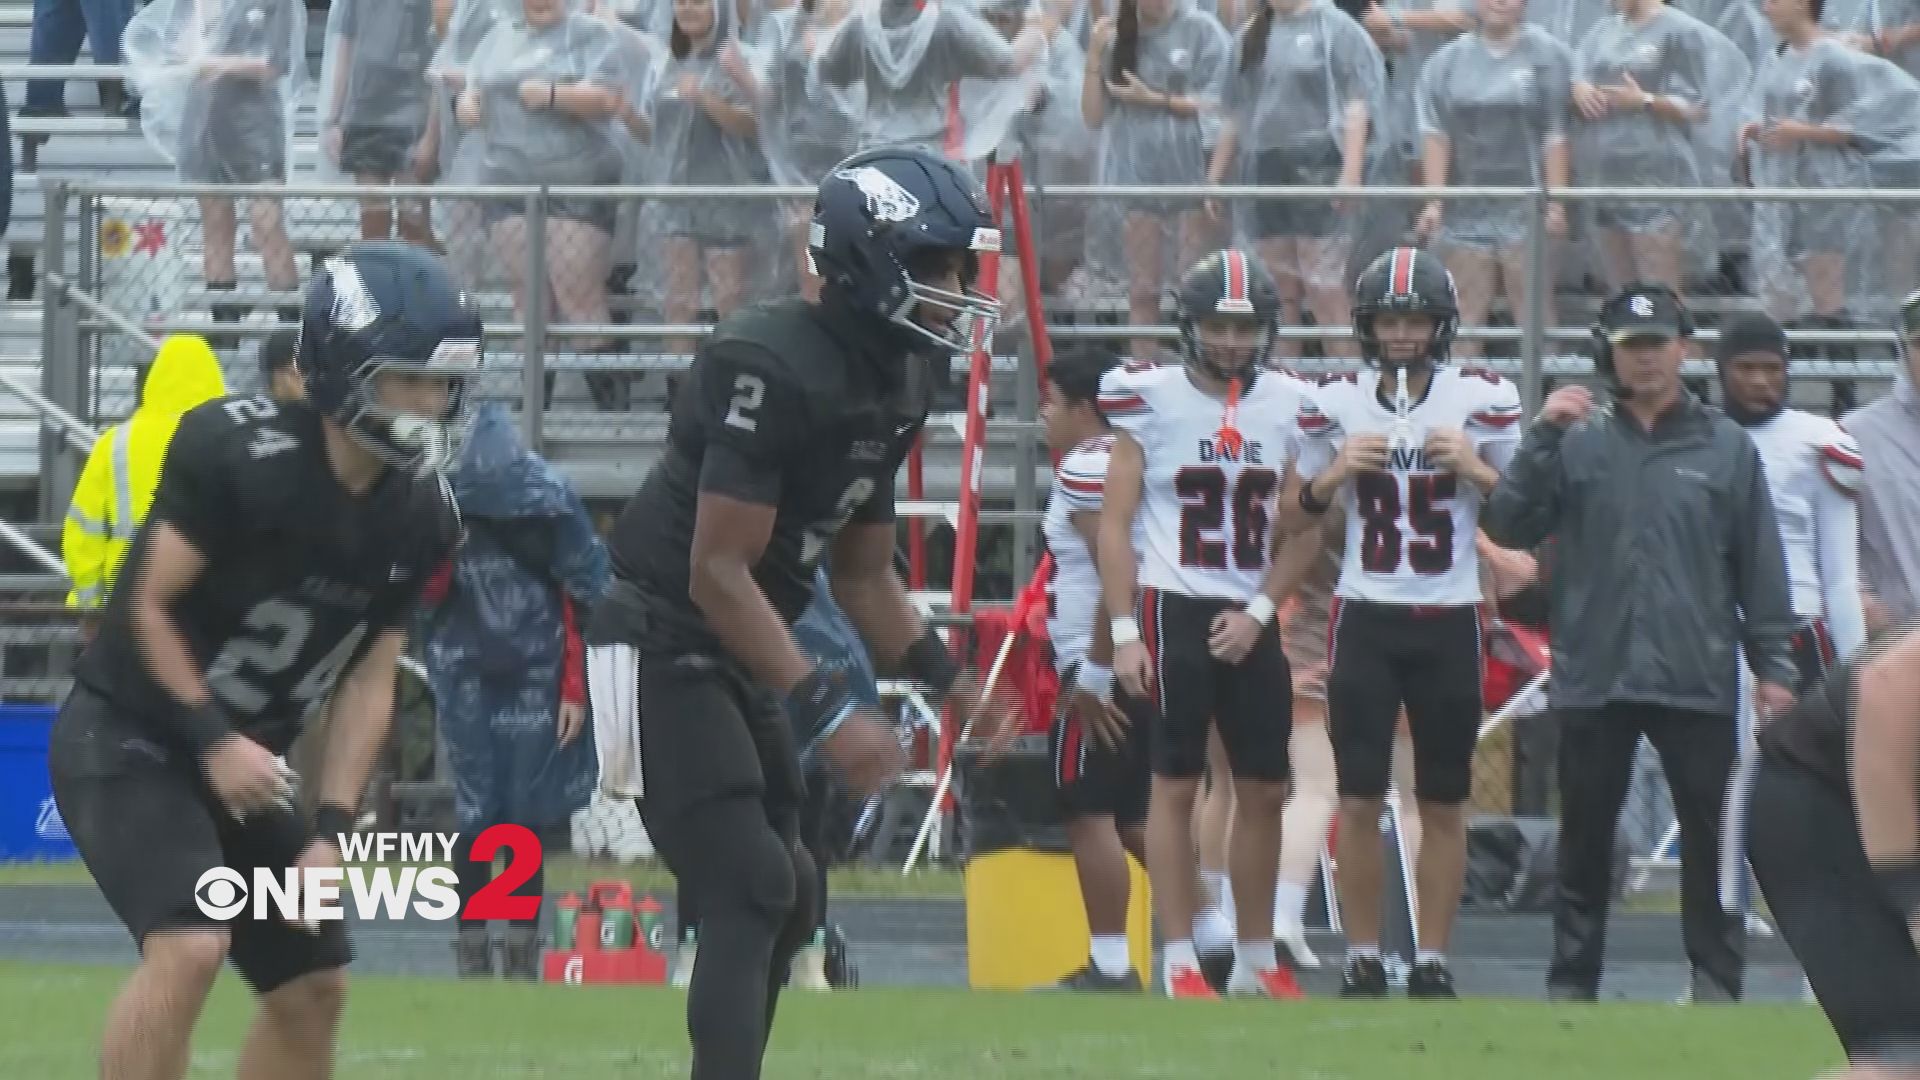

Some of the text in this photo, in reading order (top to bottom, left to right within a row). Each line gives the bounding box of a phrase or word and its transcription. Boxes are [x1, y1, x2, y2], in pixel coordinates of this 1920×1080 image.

[221, 394, 301, 460] 24
[724, 373, 765, 432] 2
[1174, 466, 1278, 571] 26
[1356, 471, 1457, 574] 85
